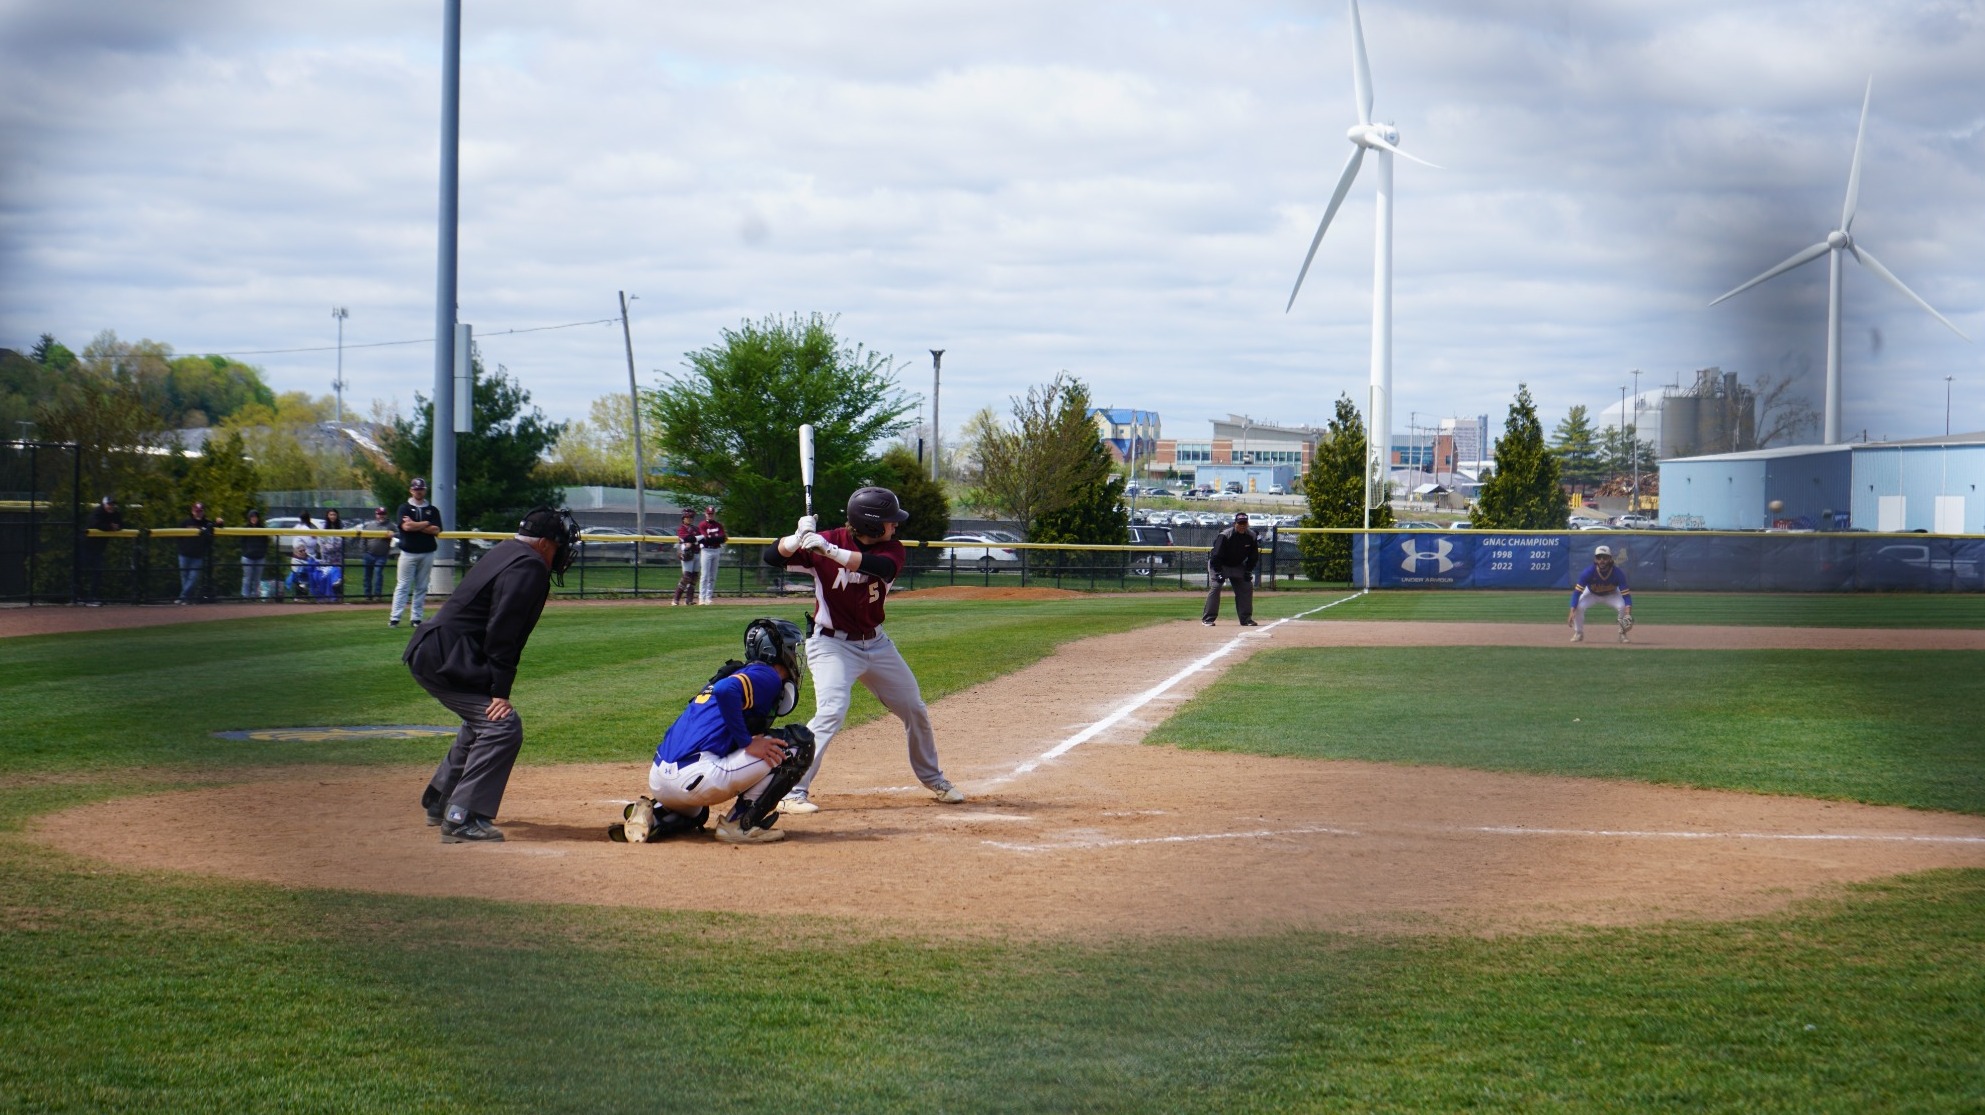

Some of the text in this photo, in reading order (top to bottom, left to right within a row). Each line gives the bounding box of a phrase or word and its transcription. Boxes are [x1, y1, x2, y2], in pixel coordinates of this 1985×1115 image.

[1483, 538, 1559, 546] GNAC CHAMPIONS
[1492, 551, 1513, 559] 1998
[1530, 551, 1551, 559] 2021
[1491, 562, 1513, 571] 2022
[1530, 563, 1551, 571] 2023
[868, 581, 880, 604] 5
